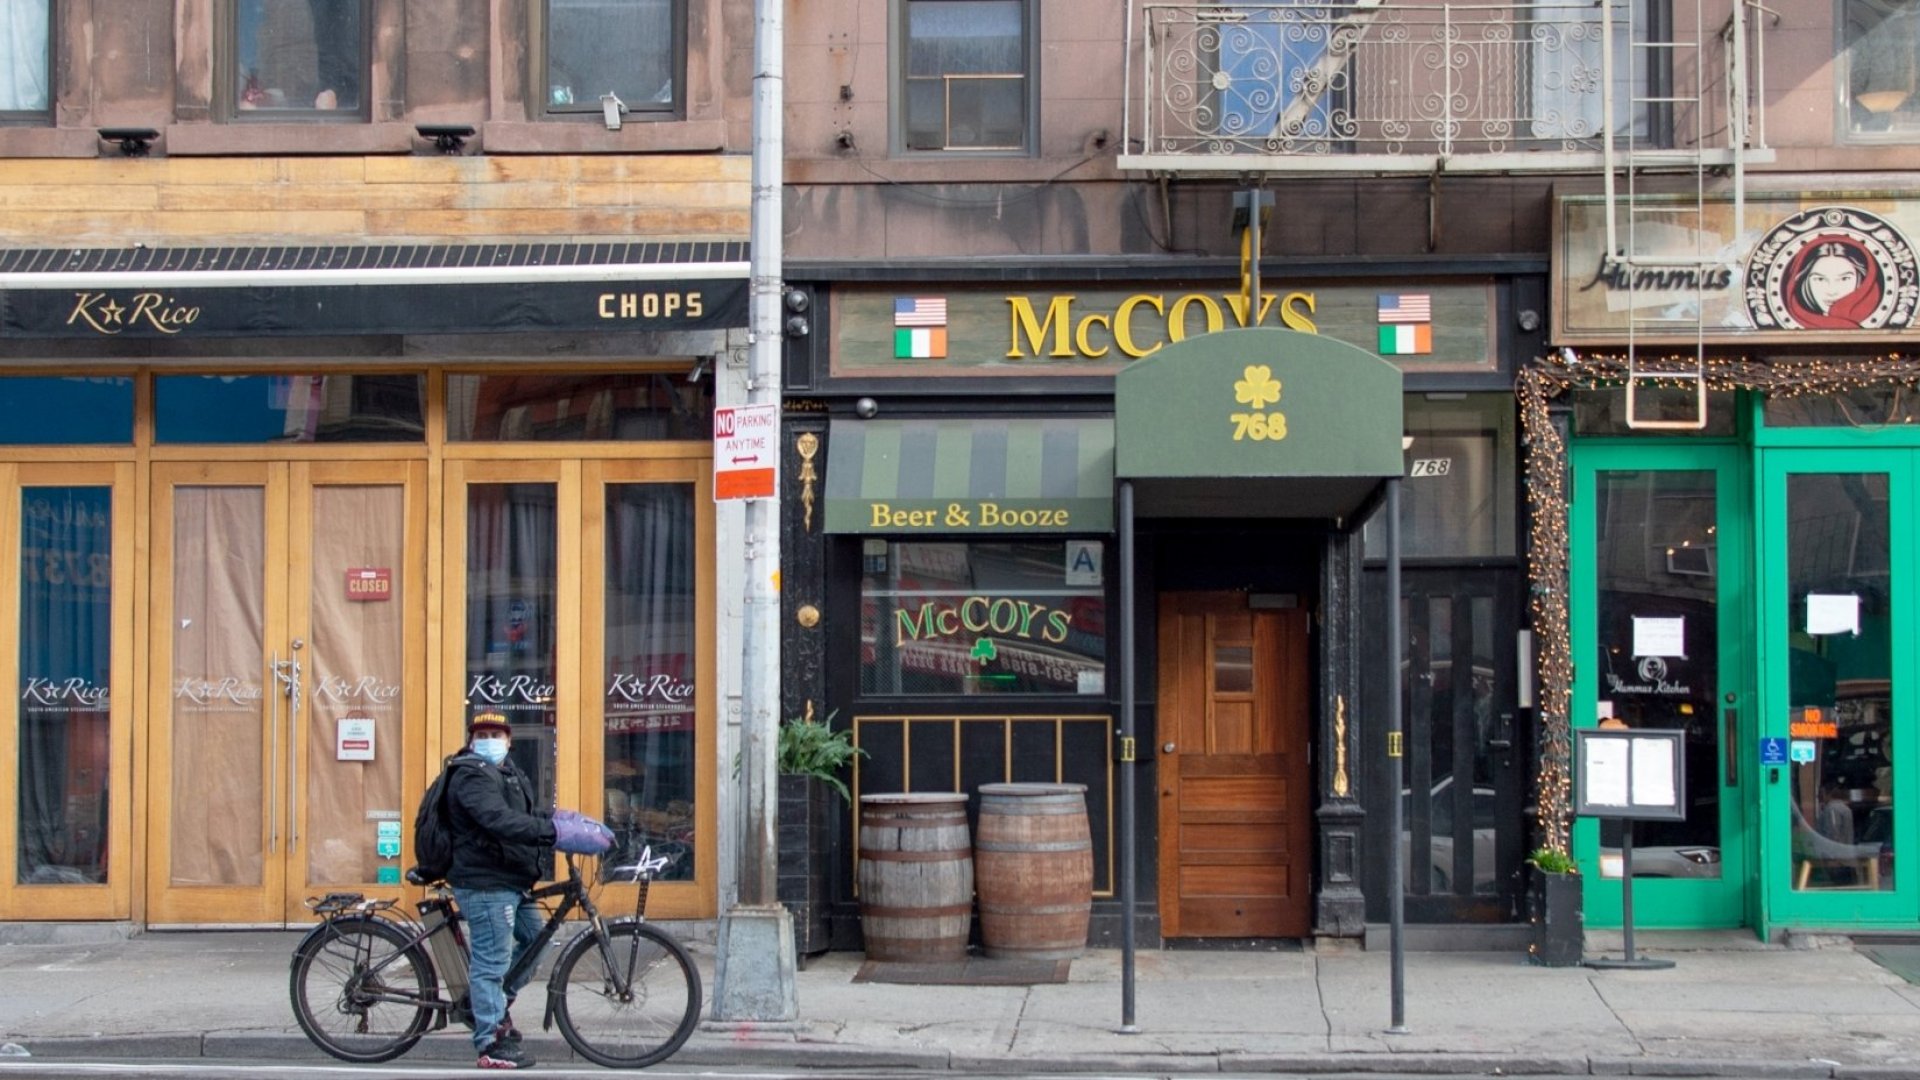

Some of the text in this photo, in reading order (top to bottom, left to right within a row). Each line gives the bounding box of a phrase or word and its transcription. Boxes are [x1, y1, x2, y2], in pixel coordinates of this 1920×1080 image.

[1579, 248, 1732, 291] Hummus
[599, 293, 702, 318] CHOPS
[716, 412, 772, 435] NO PARKING
[1230, 412, 1287, 441] 768
[726, 437, 765, 451] ANYTIME
[1414, 460, 1448, 476] 768
[870, 502, 1069, 527] Beer & Booze
[1072, 546, 1096, 572] A
[350, 579, 389, 593] CLOSED
[894, 596, 1073, 648] McCOYS
[1654, 678, 1690, 694] Kitchen
[1804, 708, 1820, 723] NO
[1790, 723, 1837, 737] SMOKING
